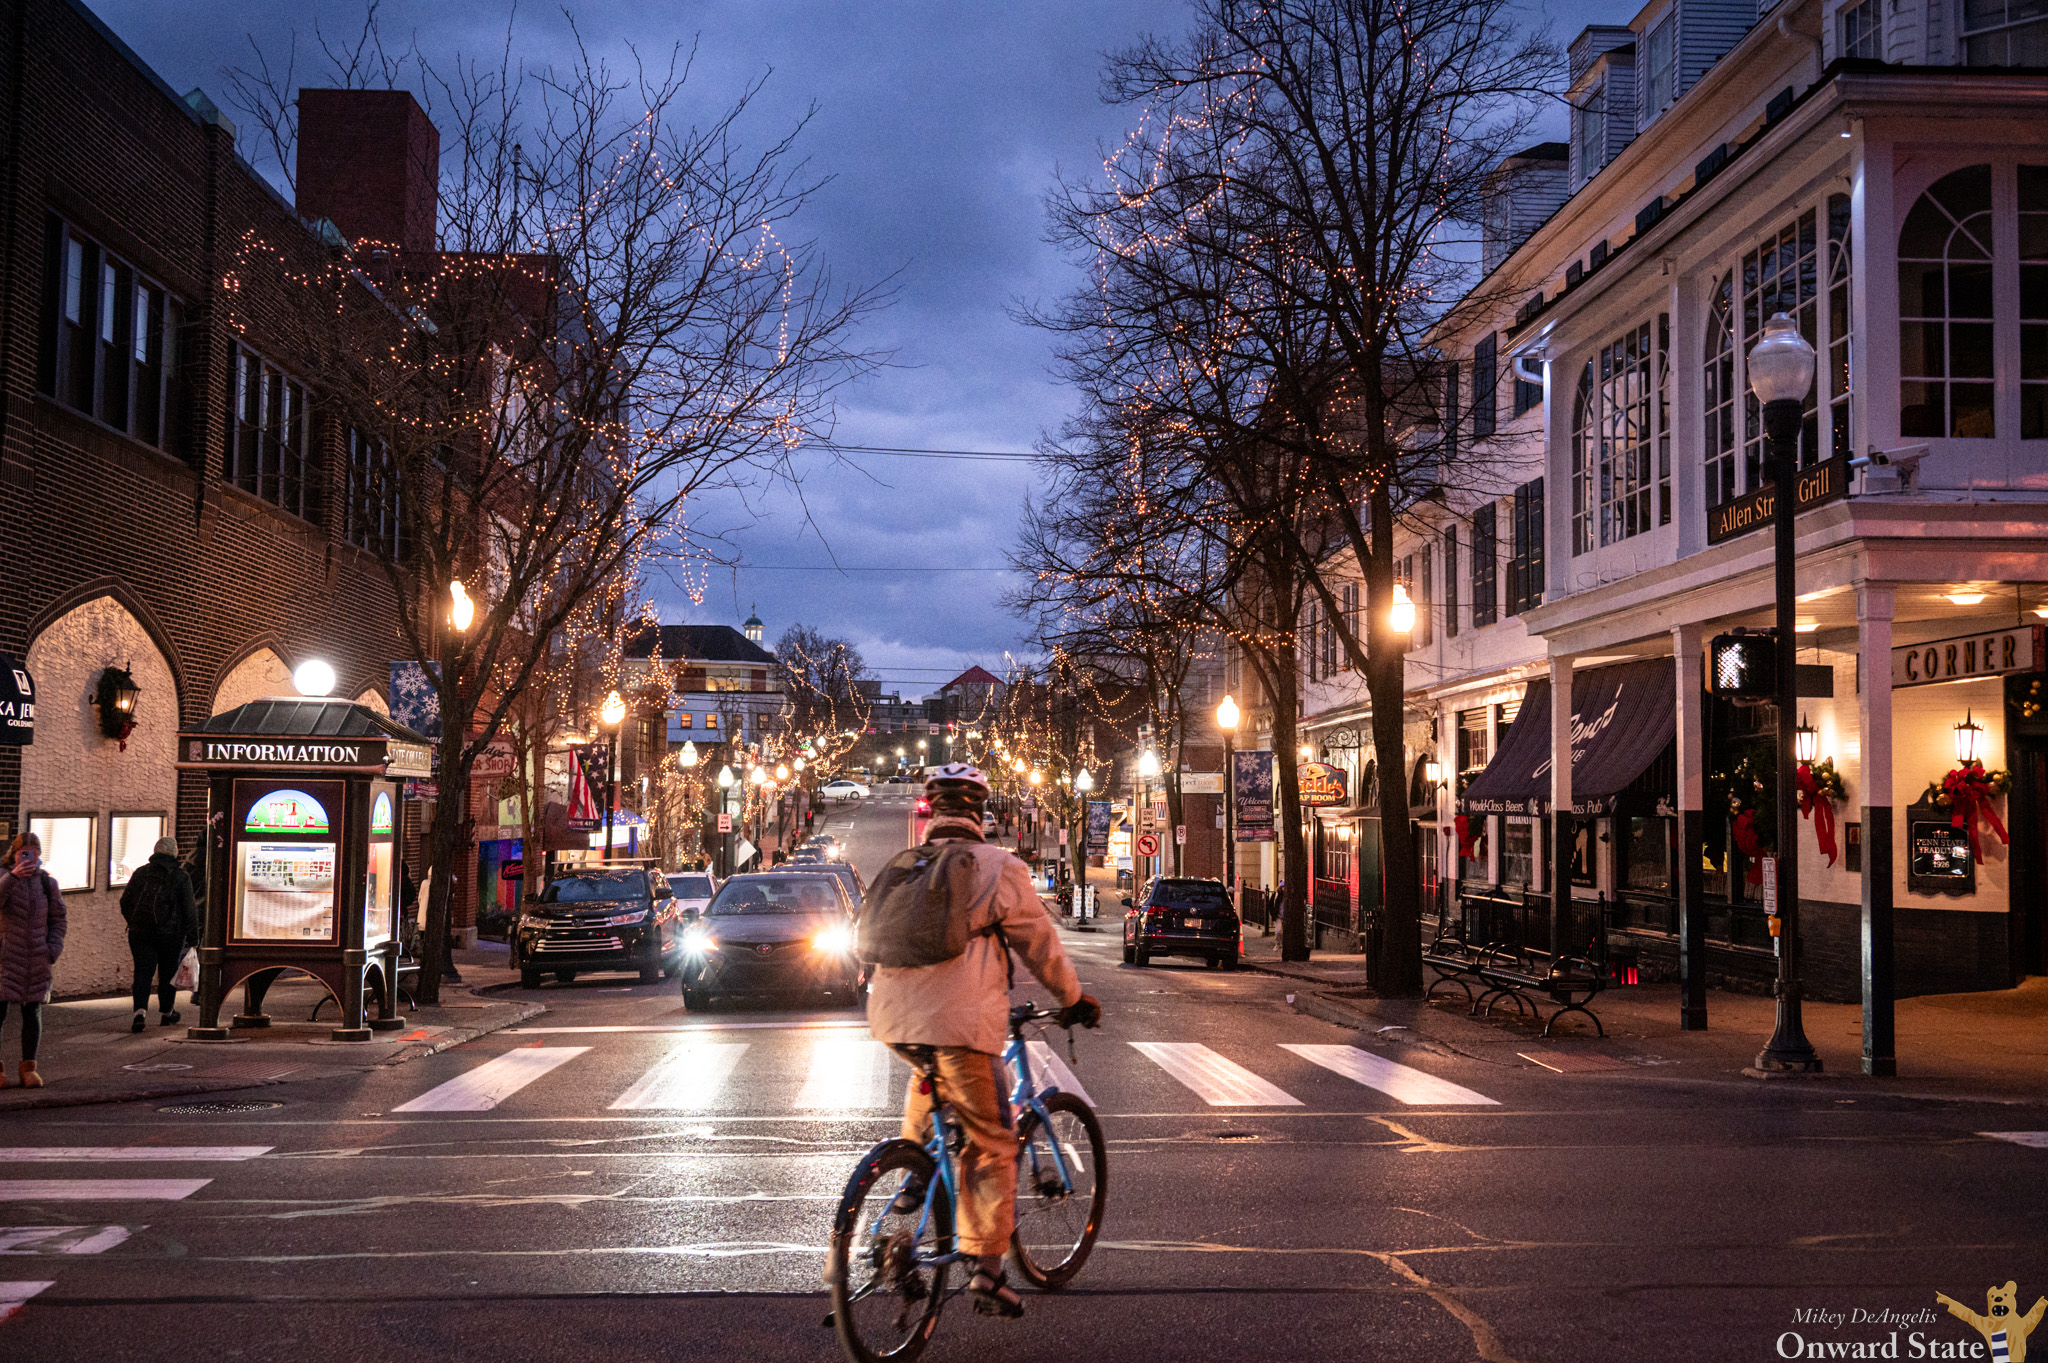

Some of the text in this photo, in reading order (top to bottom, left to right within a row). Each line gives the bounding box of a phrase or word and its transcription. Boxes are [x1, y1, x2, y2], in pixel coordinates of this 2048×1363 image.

[1720, 467, 1829, 534] Allen Str Grill
[1905, 635, 2015, 681] CORNER
[206, 743, 360, 763] INFORMATION
[485, 758, 509, 771] SHOP
[1237, 796, 1272, 806] Welcome
[1469, 799, 1504, 812] World-Class
[1505, 800, 1524, 812] Beers
[1586, 798, 1603, 814] Pub
[1932, 830, 1949, 838] THE
[1916, 838, 1966, 847] PENN STATE
